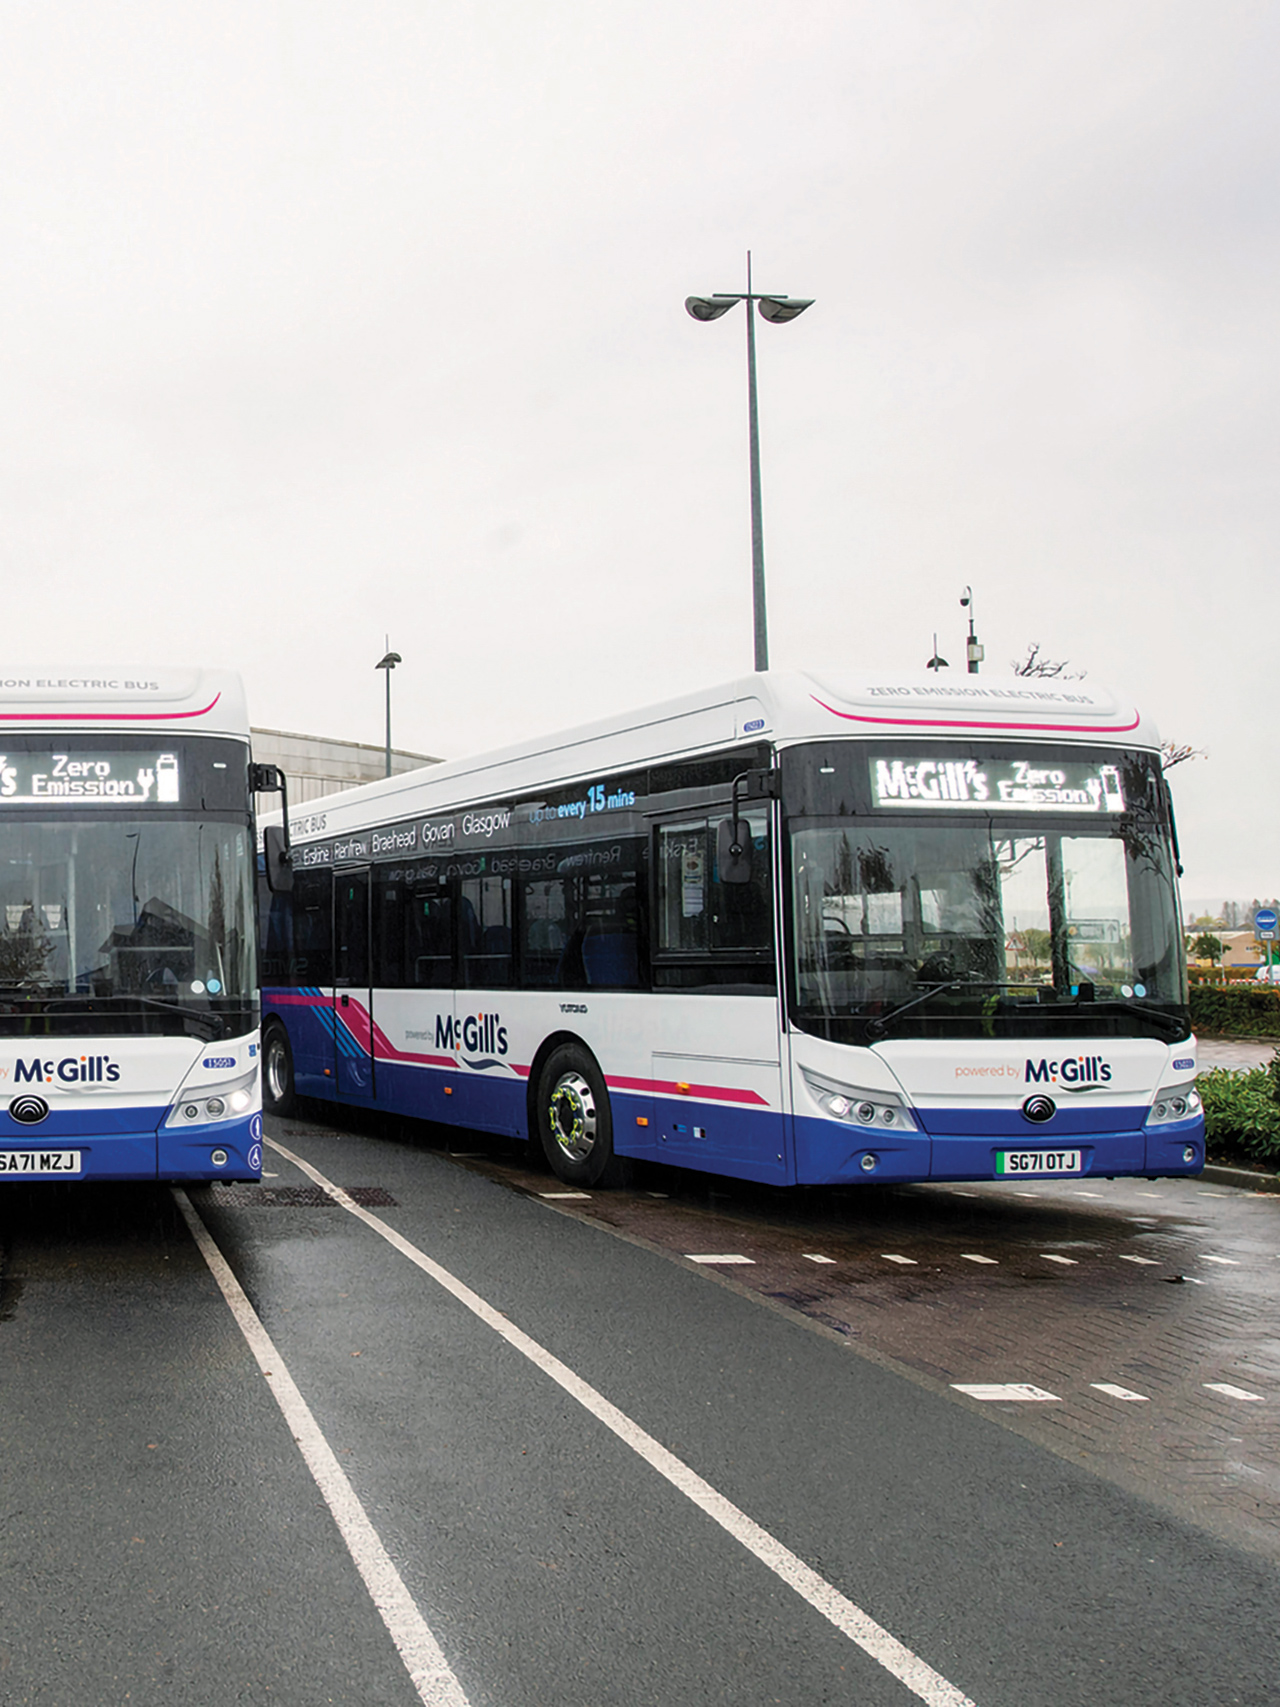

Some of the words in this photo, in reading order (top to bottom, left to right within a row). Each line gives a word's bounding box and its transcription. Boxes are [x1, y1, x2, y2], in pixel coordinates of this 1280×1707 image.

[36, 679, 119, 689] ELECTRIC
[124, 681, 160, 691] BUS
[867, 686, 911, 697] ZERO
[911, 687, 989, 698] EMISSION
[991, 689, 1059, 702] ELECTRIC
[1061, 694, 1095, 704] BUS
[52, 755, 110, 777] Zero
[1011, 762, 1065, 784] Zero
[32, 774, 135, 796] Emission
[875, 760, 990, 800] McGill's
[544, 807, 556, 821] to
[557, 801, 586, 820] every
[587, 784, 606, 812] 15
[607, 791, 635, 809] mins
[997, 780, 1089, 804] Emission
[311, 814, 327, 833] BUS
[372, 826, 416, 852] Braehead
[422, 822, 455, 842] Govan
[462, 812, 510, 837] Glasgow
[435, 1013, 509, 1056] McGill's
[14, 1055, 121, 1083] McGill's
[955, 1064, 1005, 1079] powered
[1006, 1065, 1020, 1080] by
[1025, 1056, 1112, 1082] McGill's
[39, 1153, 74, 1171] MZJ
[1009, 1154, 1043, 1171] SG71
[1046, 1153, 1076, 1170] OTJ
